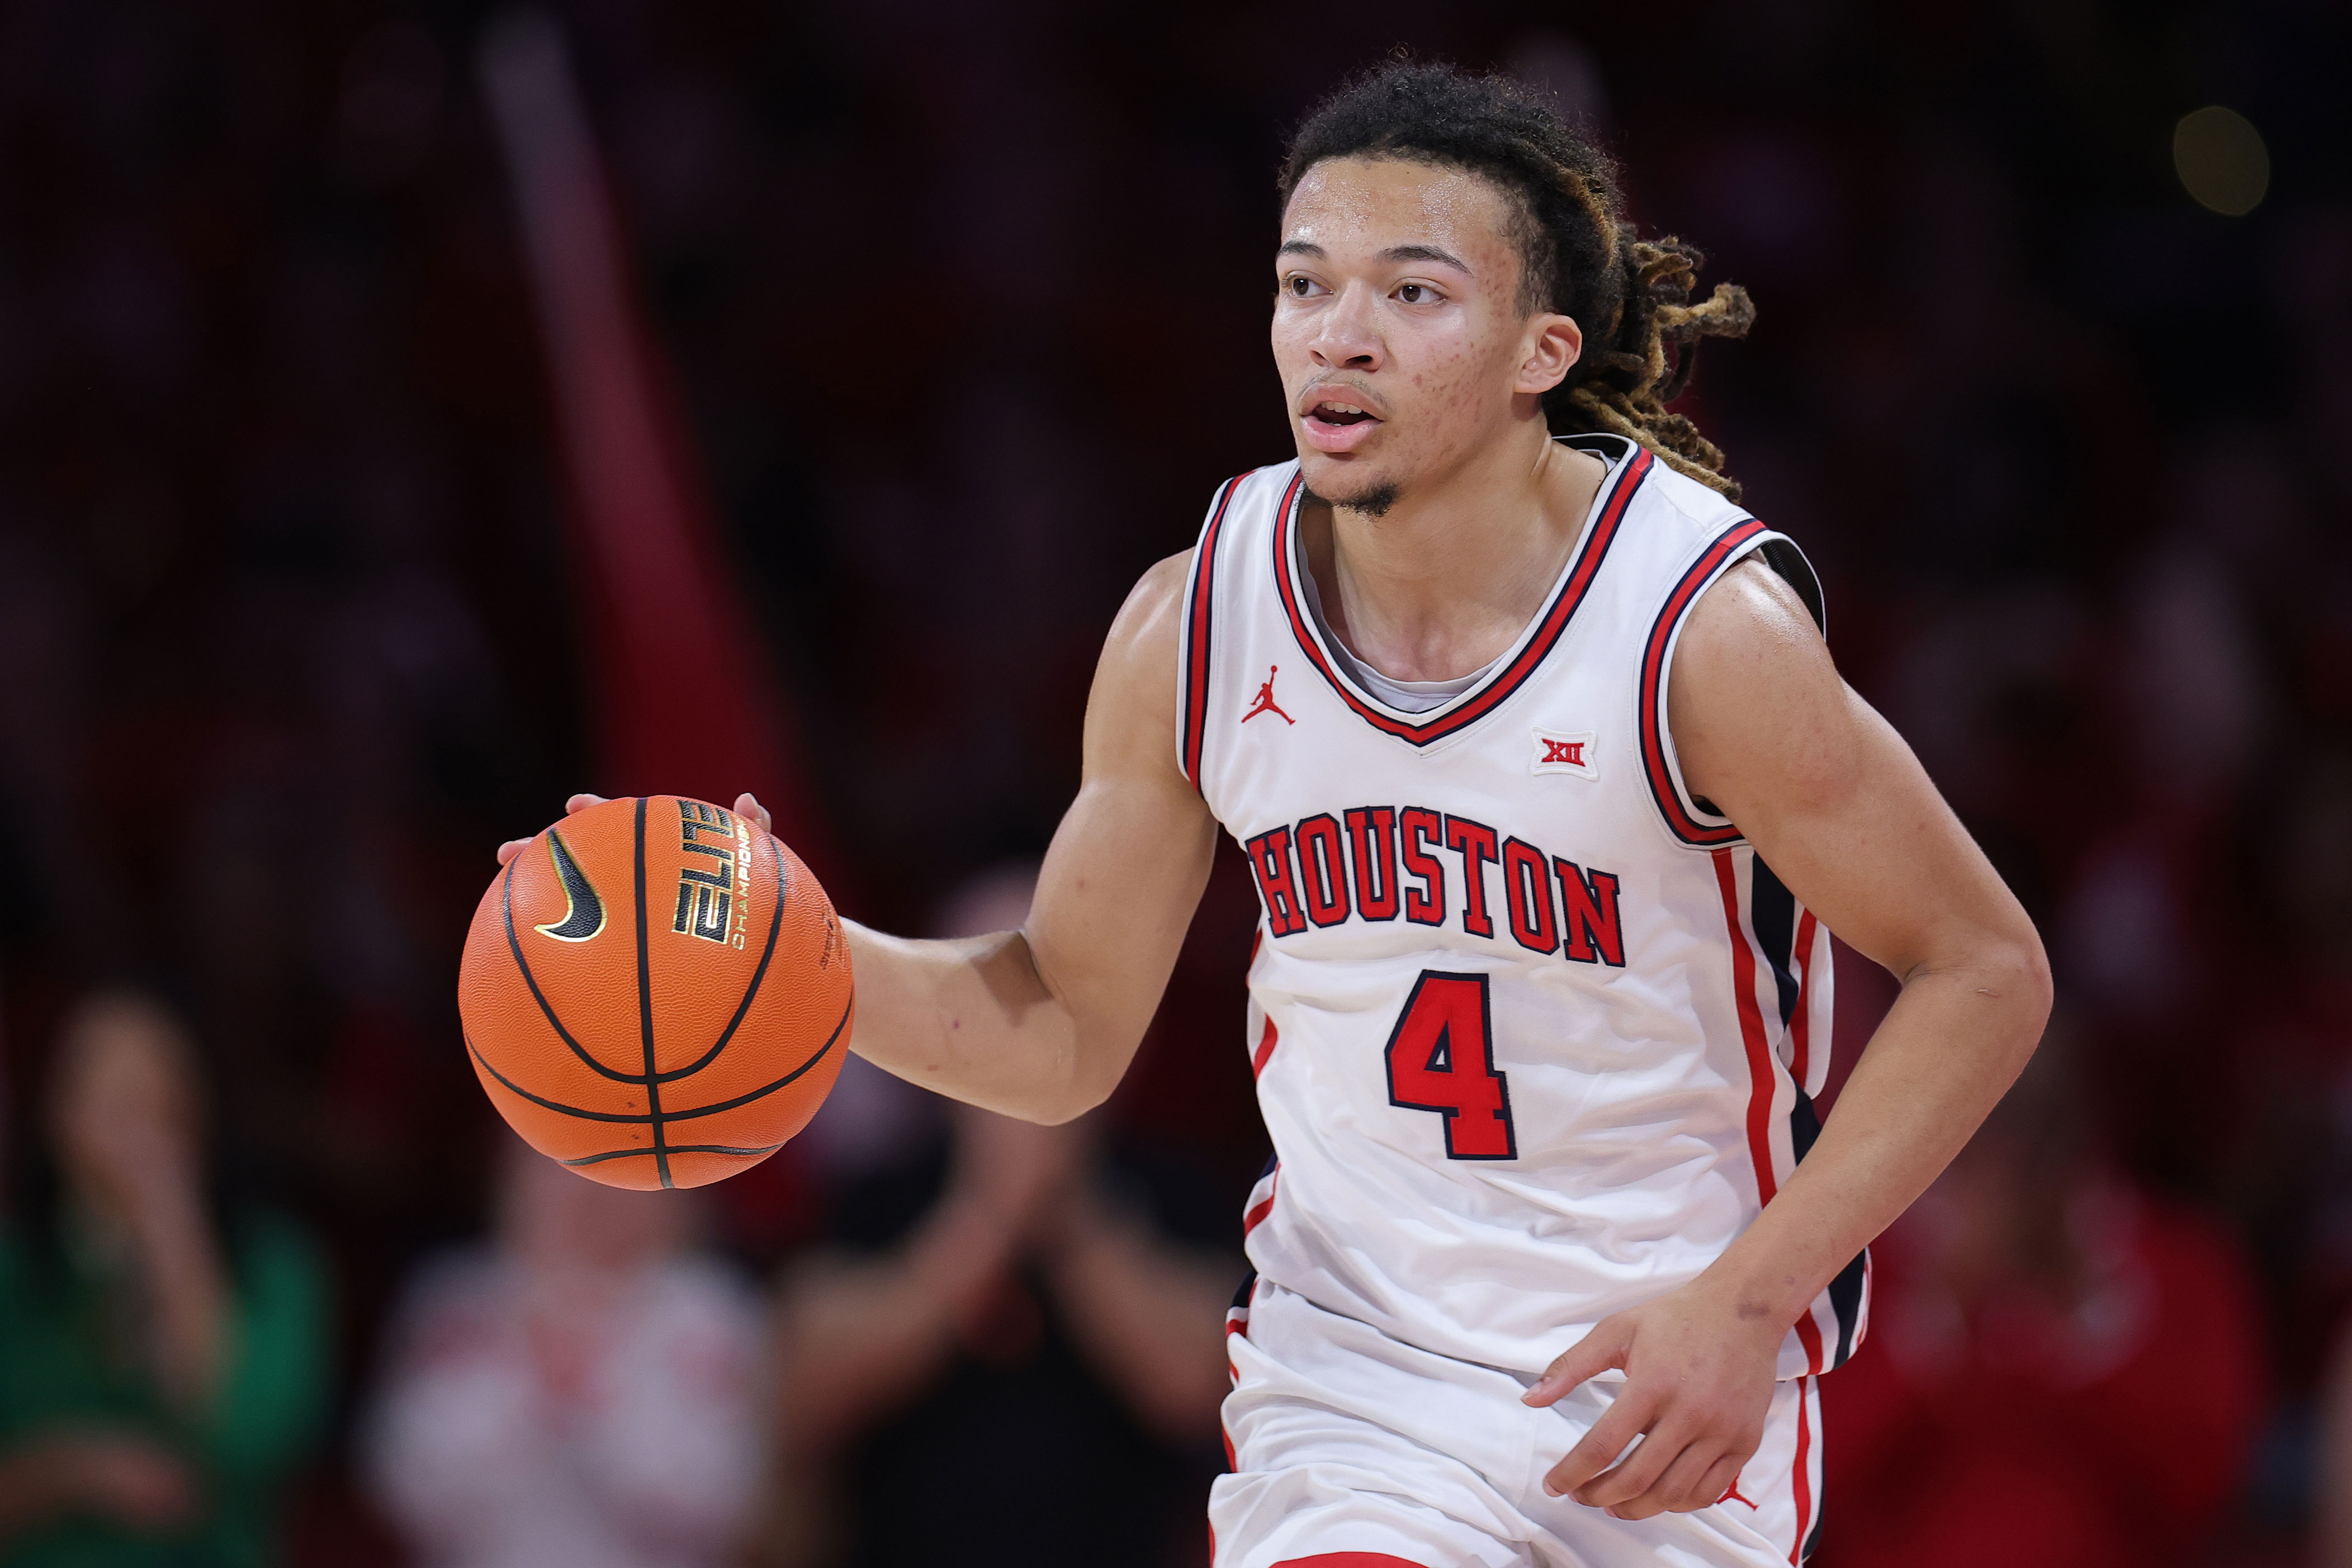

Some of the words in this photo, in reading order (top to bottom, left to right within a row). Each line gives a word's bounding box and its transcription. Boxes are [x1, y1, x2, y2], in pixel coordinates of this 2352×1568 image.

[1541, 738, 1586, 767] XII
[671, 799, 736, 945] ELITE
[1245, 806, 1626, 968] HOUSTON
[1384, 969, 1518, 1160] 4
